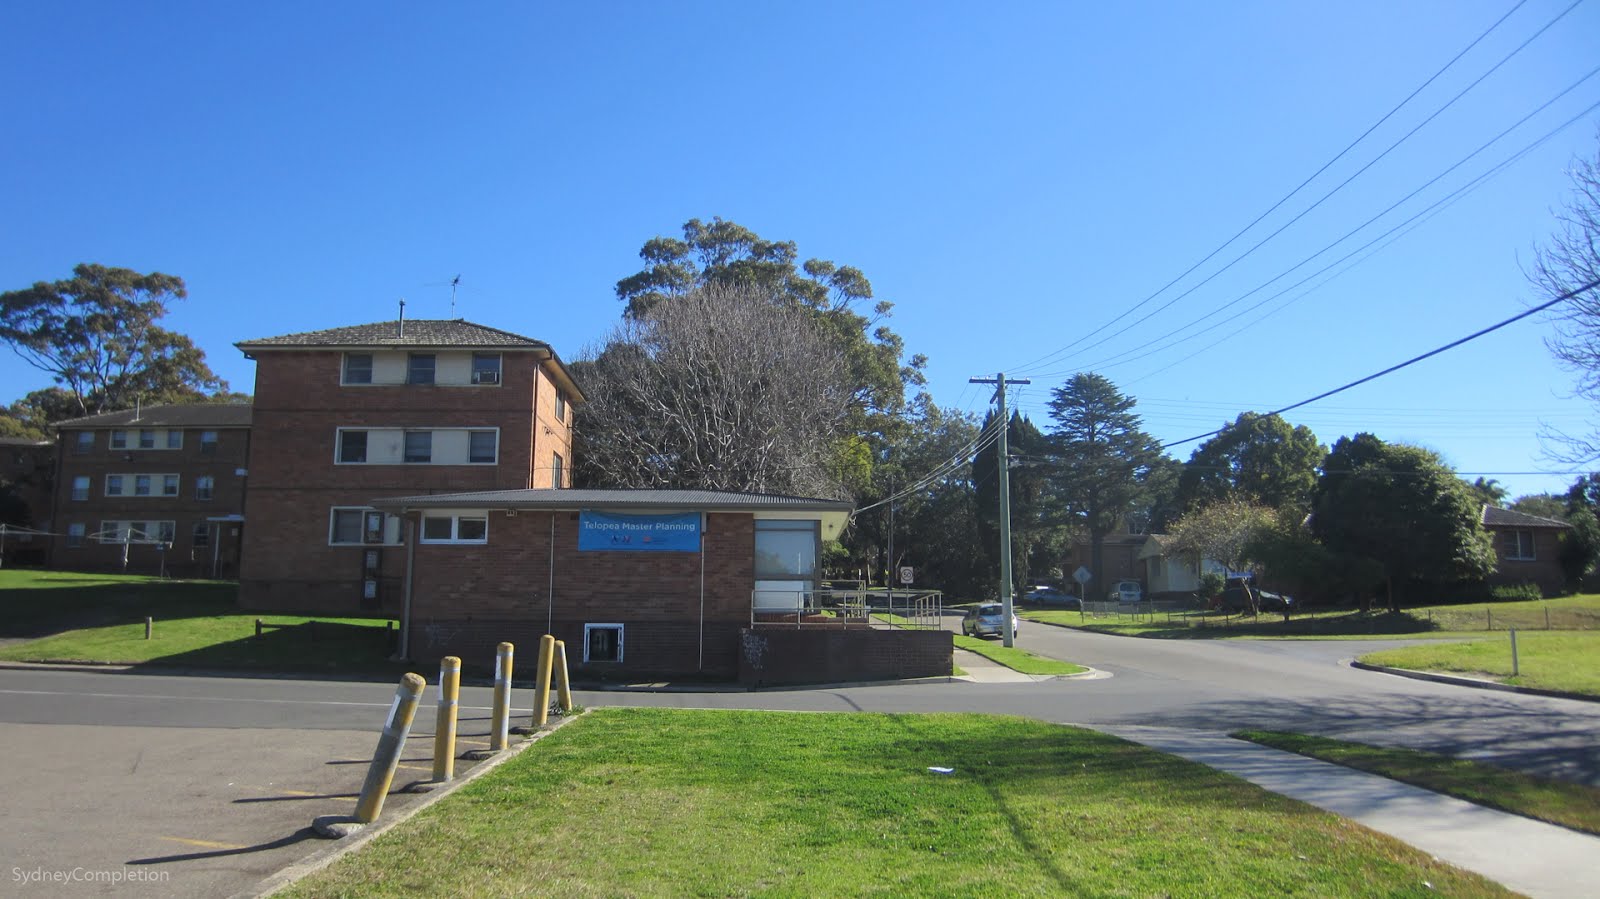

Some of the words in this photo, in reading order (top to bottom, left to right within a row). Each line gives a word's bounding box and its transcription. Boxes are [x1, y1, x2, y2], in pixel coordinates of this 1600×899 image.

[584, 521, 620, 531] Telopea
[622, 522, 652, 530] Master
[655, 522, 696, 531] Planning
